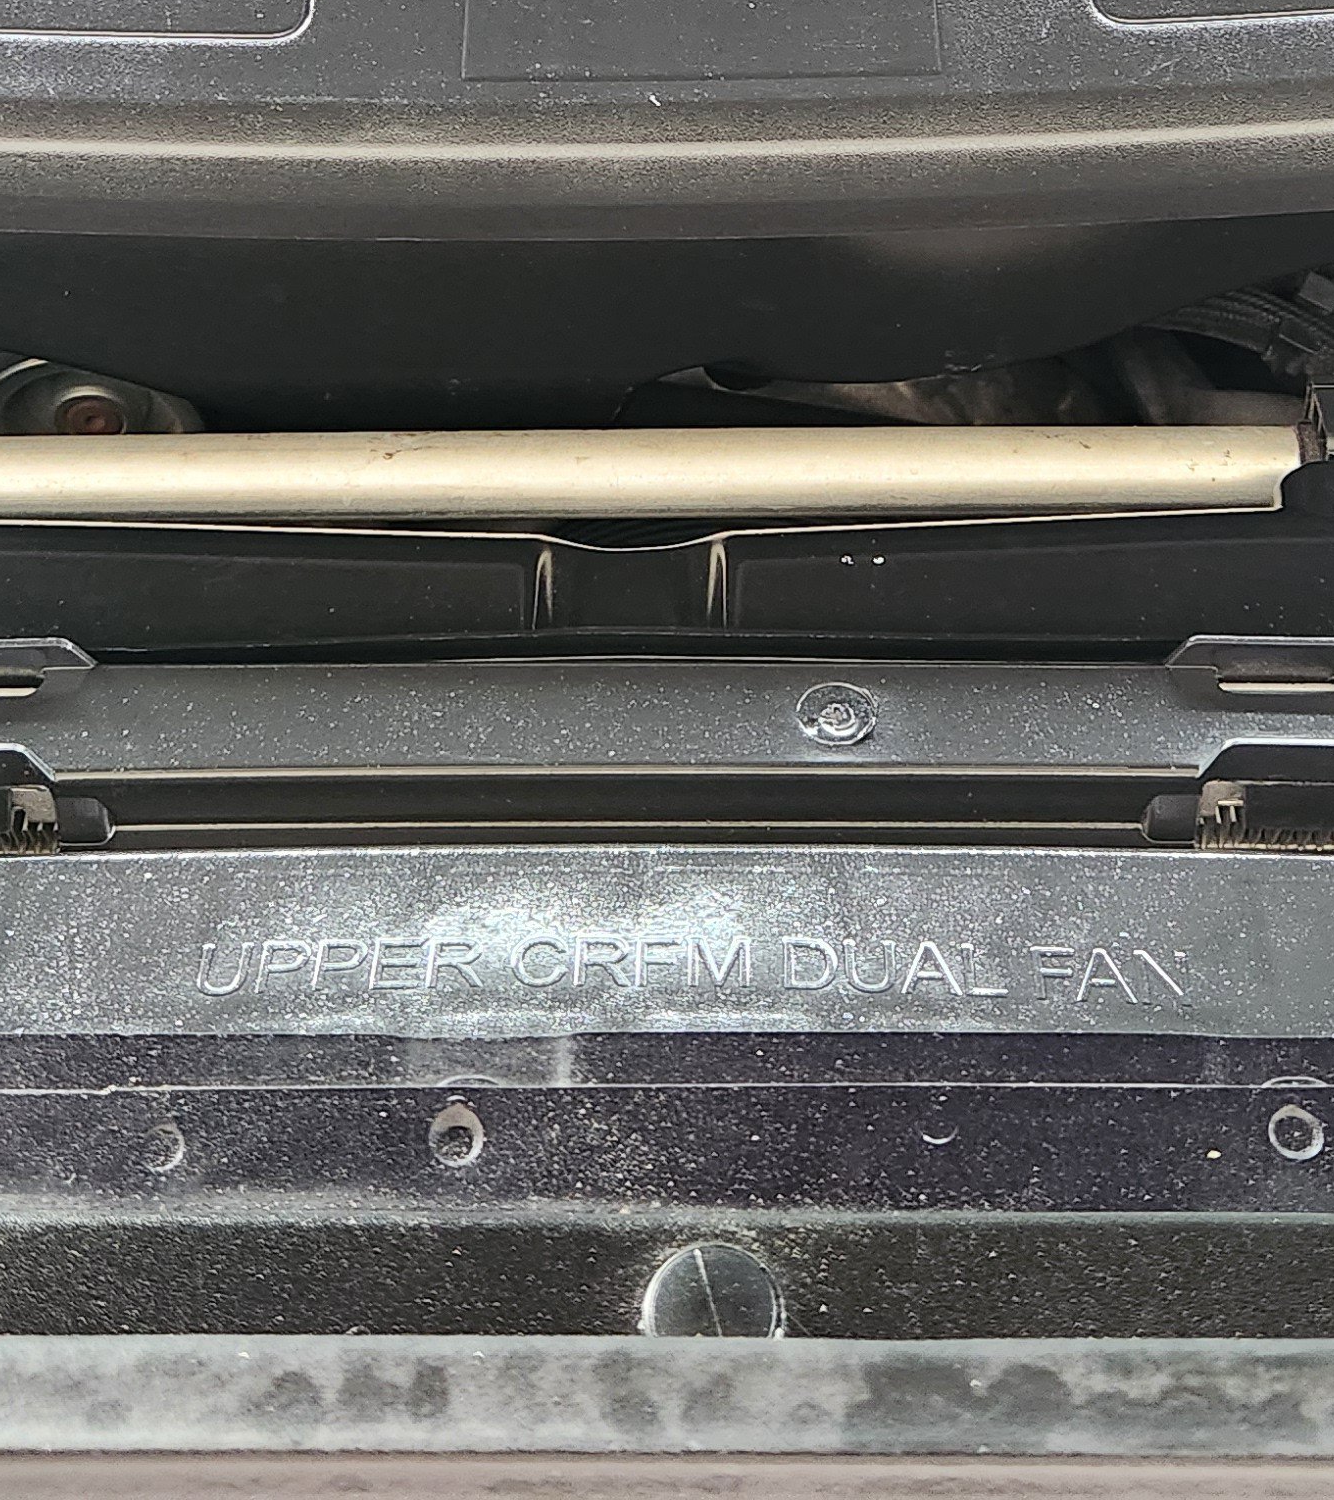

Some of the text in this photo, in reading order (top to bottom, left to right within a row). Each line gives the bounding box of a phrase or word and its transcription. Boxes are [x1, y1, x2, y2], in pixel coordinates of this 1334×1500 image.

[196, 934, 1188, 1006] UPPER CRFM DUAL FAN
